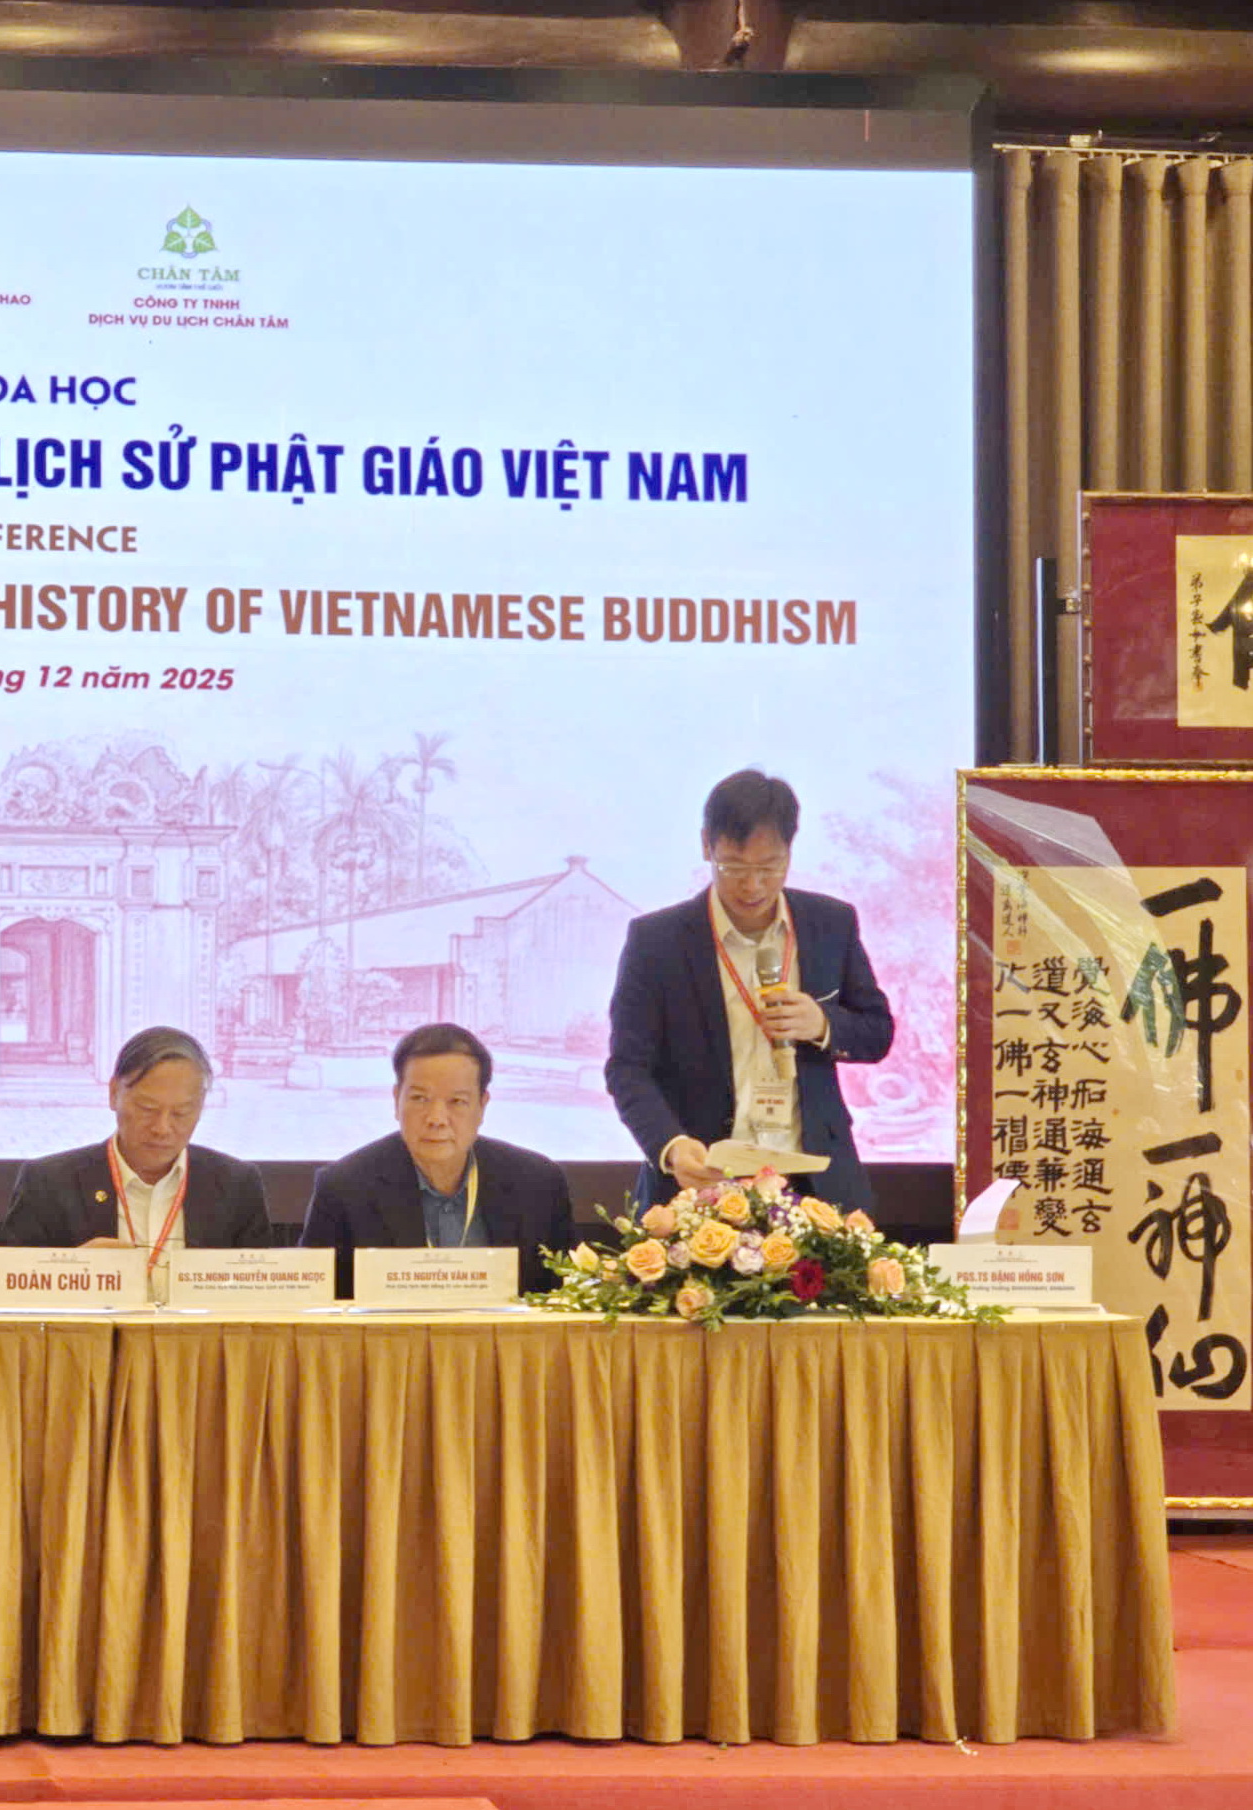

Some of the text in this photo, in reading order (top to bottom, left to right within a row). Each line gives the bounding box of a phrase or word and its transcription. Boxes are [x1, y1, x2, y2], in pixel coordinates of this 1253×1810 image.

[136, 264, 241, 283] CHÂN TÂM
[133, 294, 240, 310] CÔNG TY TNHH
[88, 313, 289, 329] DỊCH VỤ DU LỊCH CHÂN TÂM
[49, 375, 137, 411] HỌC
[121, 423, 198, 491] SỬ
[210, 432, 345, 505] PHẬT
[362, 436, 483, 498] GIÁO
[501, 439, 610, 511] VIỆT
[628, 451, 748, 503] NAM
[206, 587, 263, 635] OF
[278, 589, 585, 642] VIETNAMESE
[603, 596, 857, 646] BUDDHISM
[39, 665, 73, 688] 12
[81, 665, 151, 689] năm
[159, 667, 235, 691] 2025
[6, 1268, 122, 1291] ĐOÀN CHỦ TRÌ
[233, 1269, 268, 1282] NGUYỄN
[270, 1272, 299, 1282] QUANG
[302, 1272, 326, 1283] NGỌC
[386, 1271, 411, 1281] GS.TS
[414, 1269, 448, 1281] NGUYỄN
[471, 1271, 488, 1281] KIM
[957, 1271, 988, 1282] PGS.TS
